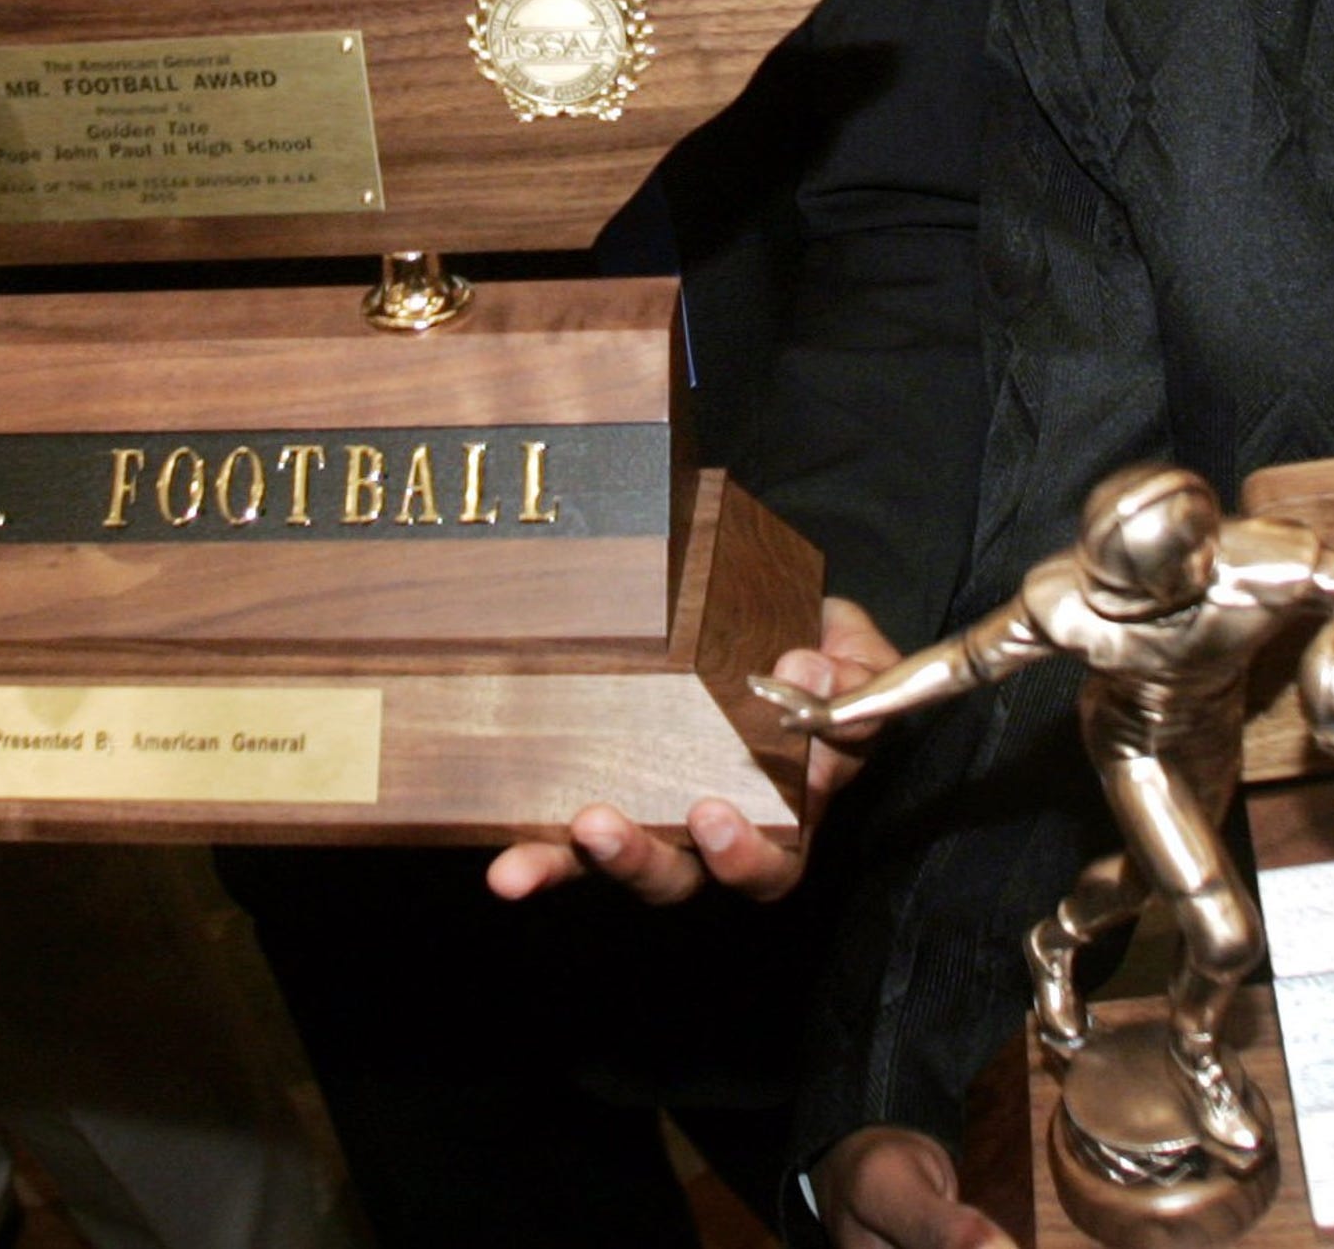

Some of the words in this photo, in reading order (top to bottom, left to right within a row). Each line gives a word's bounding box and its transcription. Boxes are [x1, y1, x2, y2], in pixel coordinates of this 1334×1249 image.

[78, 58, 158, 72] American
[163, 54, 231, 69] General
[4, 79, 49, 98] MR.
[63, 73, 179, 97] FOOTBALL
[193, 69, 277, 91] AWARD
[87, 122, 155, 141] Golden
[168, 119, 209, 137] Tate
[54, 144, 99, 162] John
[108, 141, 152, 159] Paul
[187, 138, 233, 159] High
[243, 135, 312, 155] School
[101, 439, 563, 529] FOOTBALL
[131, 729, 218, 753] American
[231, 731, 306, 754] General
